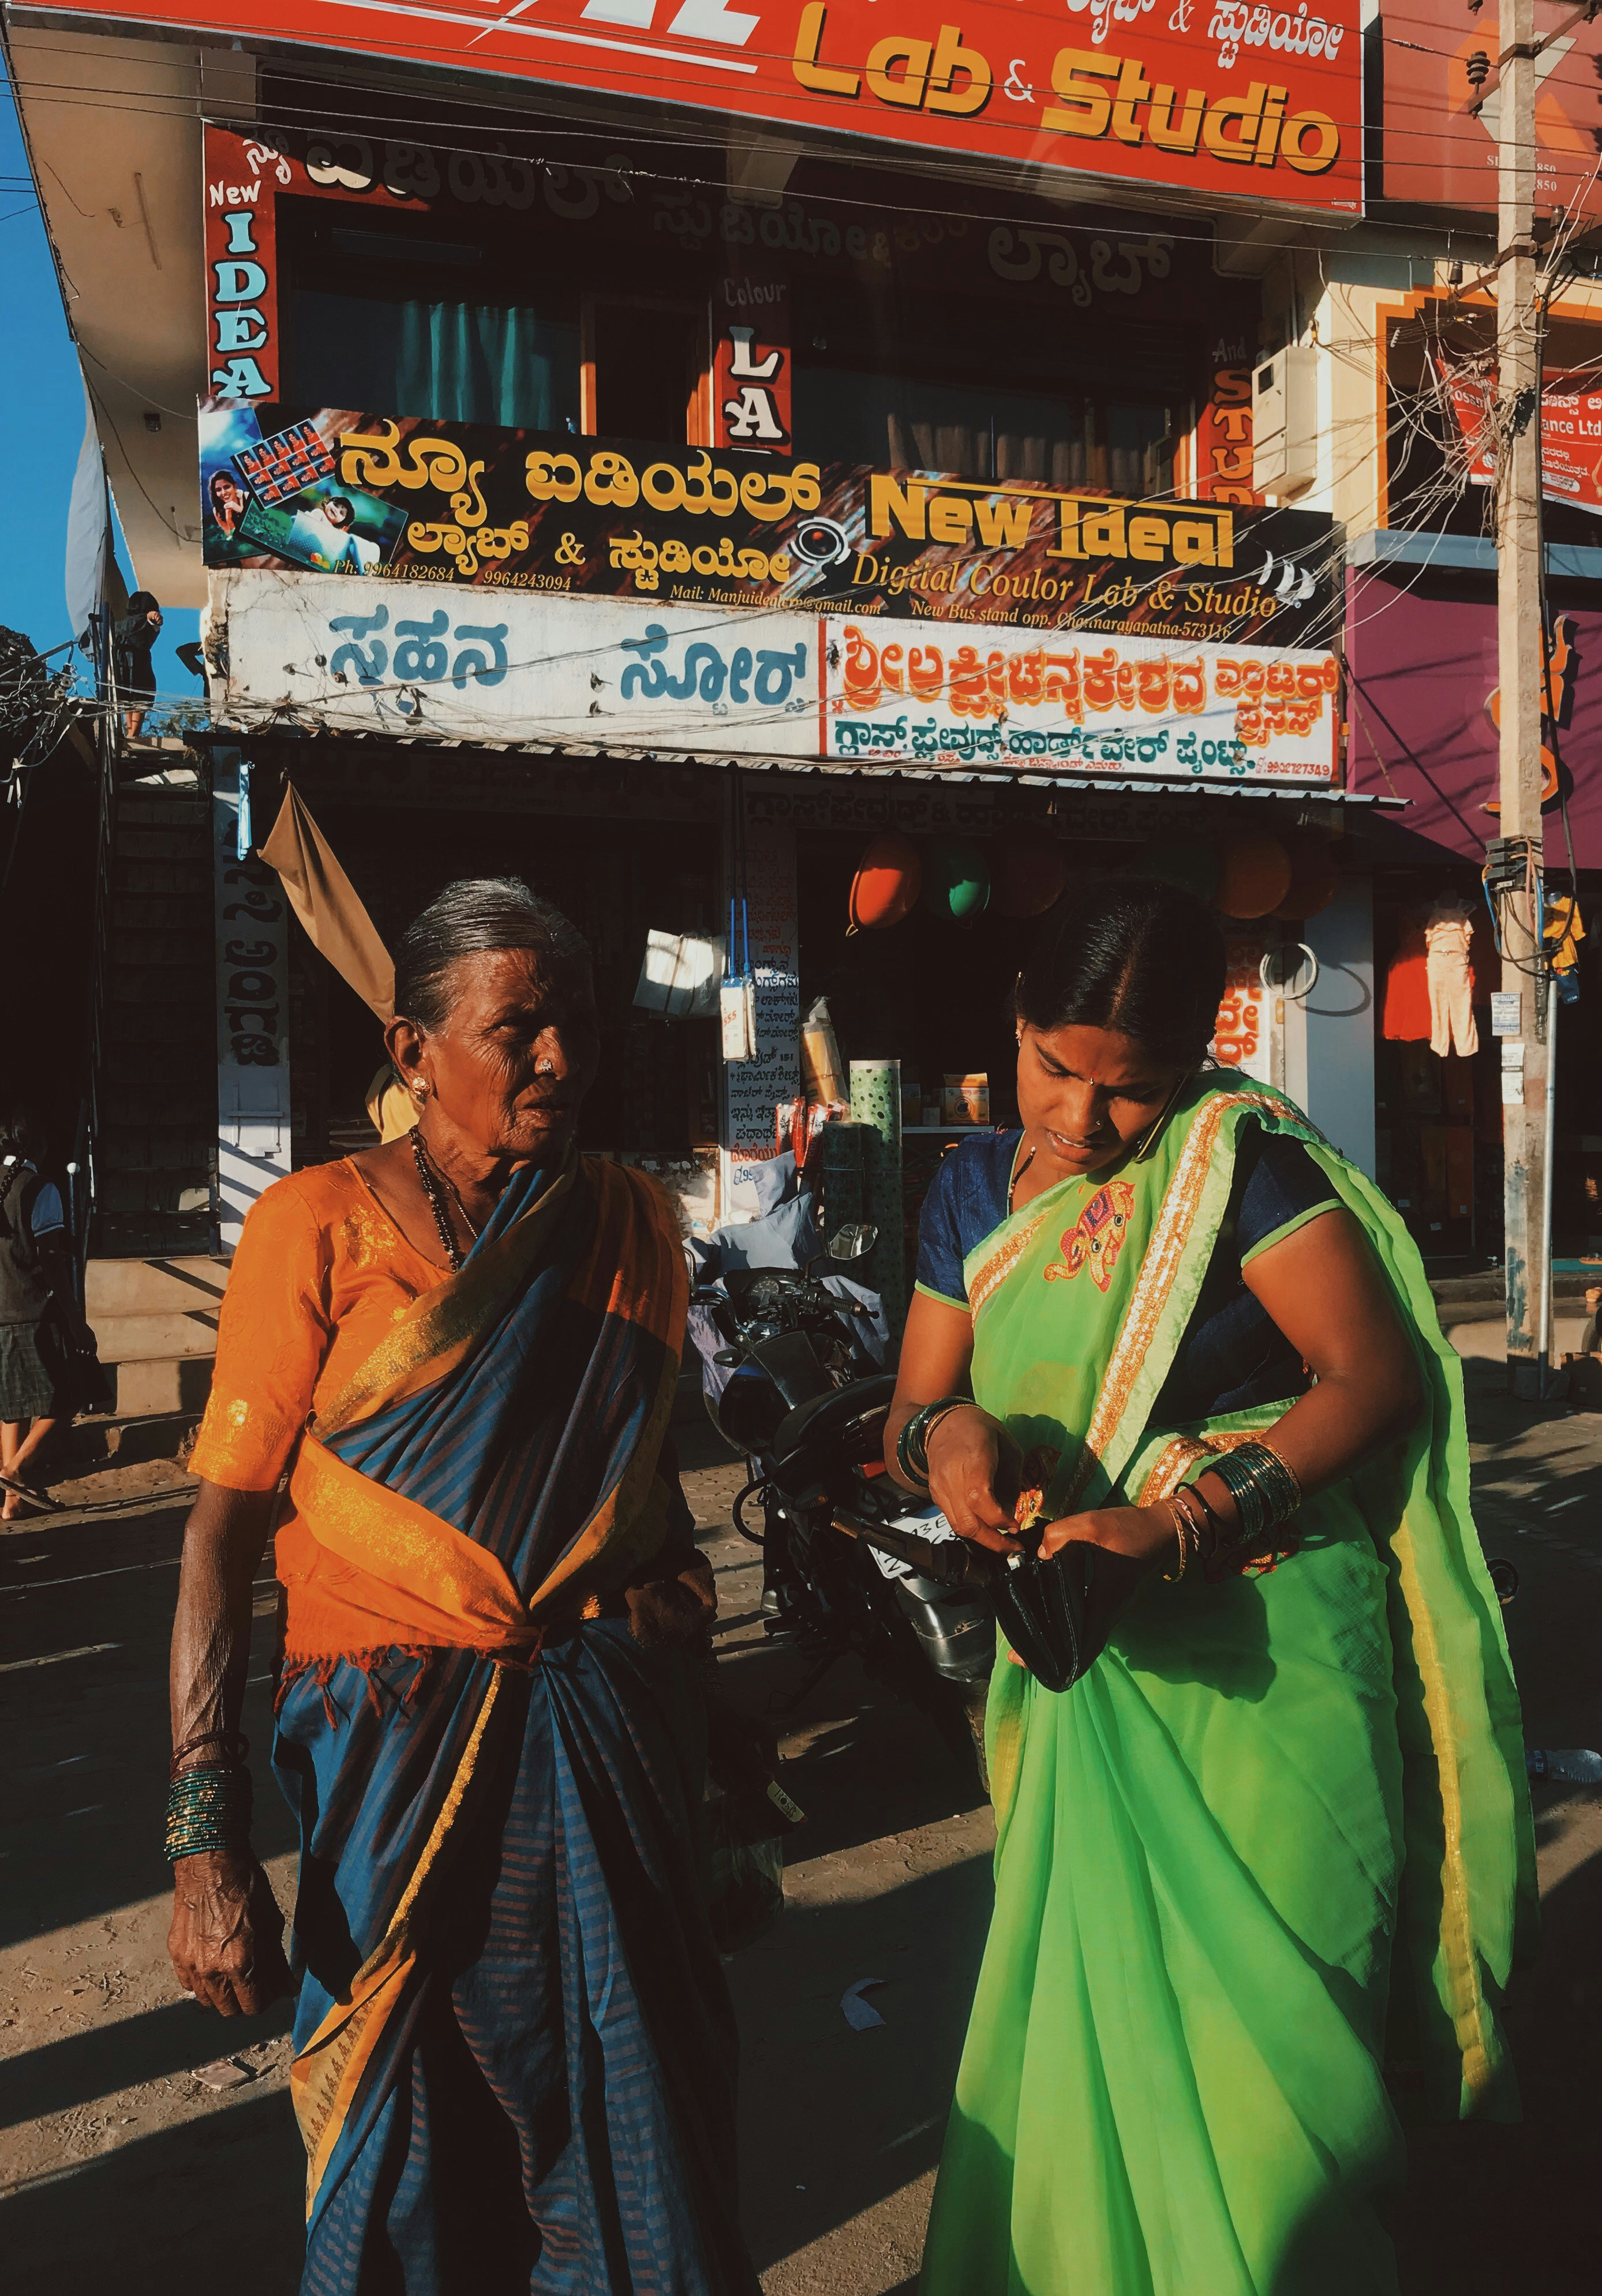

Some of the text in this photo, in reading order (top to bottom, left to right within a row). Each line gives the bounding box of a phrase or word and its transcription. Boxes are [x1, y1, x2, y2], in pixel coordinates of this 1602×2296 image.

[792, 2, 991, 114] Lab
[1004, 59, 1035, 103] &
[1040, 47, 1340, 173] Studio
[209, 181, 261, 207] New
[340, 418, 821, 527] ನ್ಯೂ ಐಡಿಯಲ್
[870, 474, 1233, 568] New Ideal
[364, 561, 455, 582] 9964182684
[484, 570, 571, 591] 9964243094
[407, 521, 790, 590] ಲ್ಯಾಬ್ & ಸ್ಟುಡಿಯೋ
[852, 554, 1278, 619] Digital Coulor Lab & Studio
[670, 585, 704, 601] Mail:
[911, 601, 944, 617] New
[948, 604, 976, 620] Bus
[979, 608, 1019, 623] stand
[1022, 613, 1051, 628] opp.
[329, 604, 508, 690] ಸಹನ
